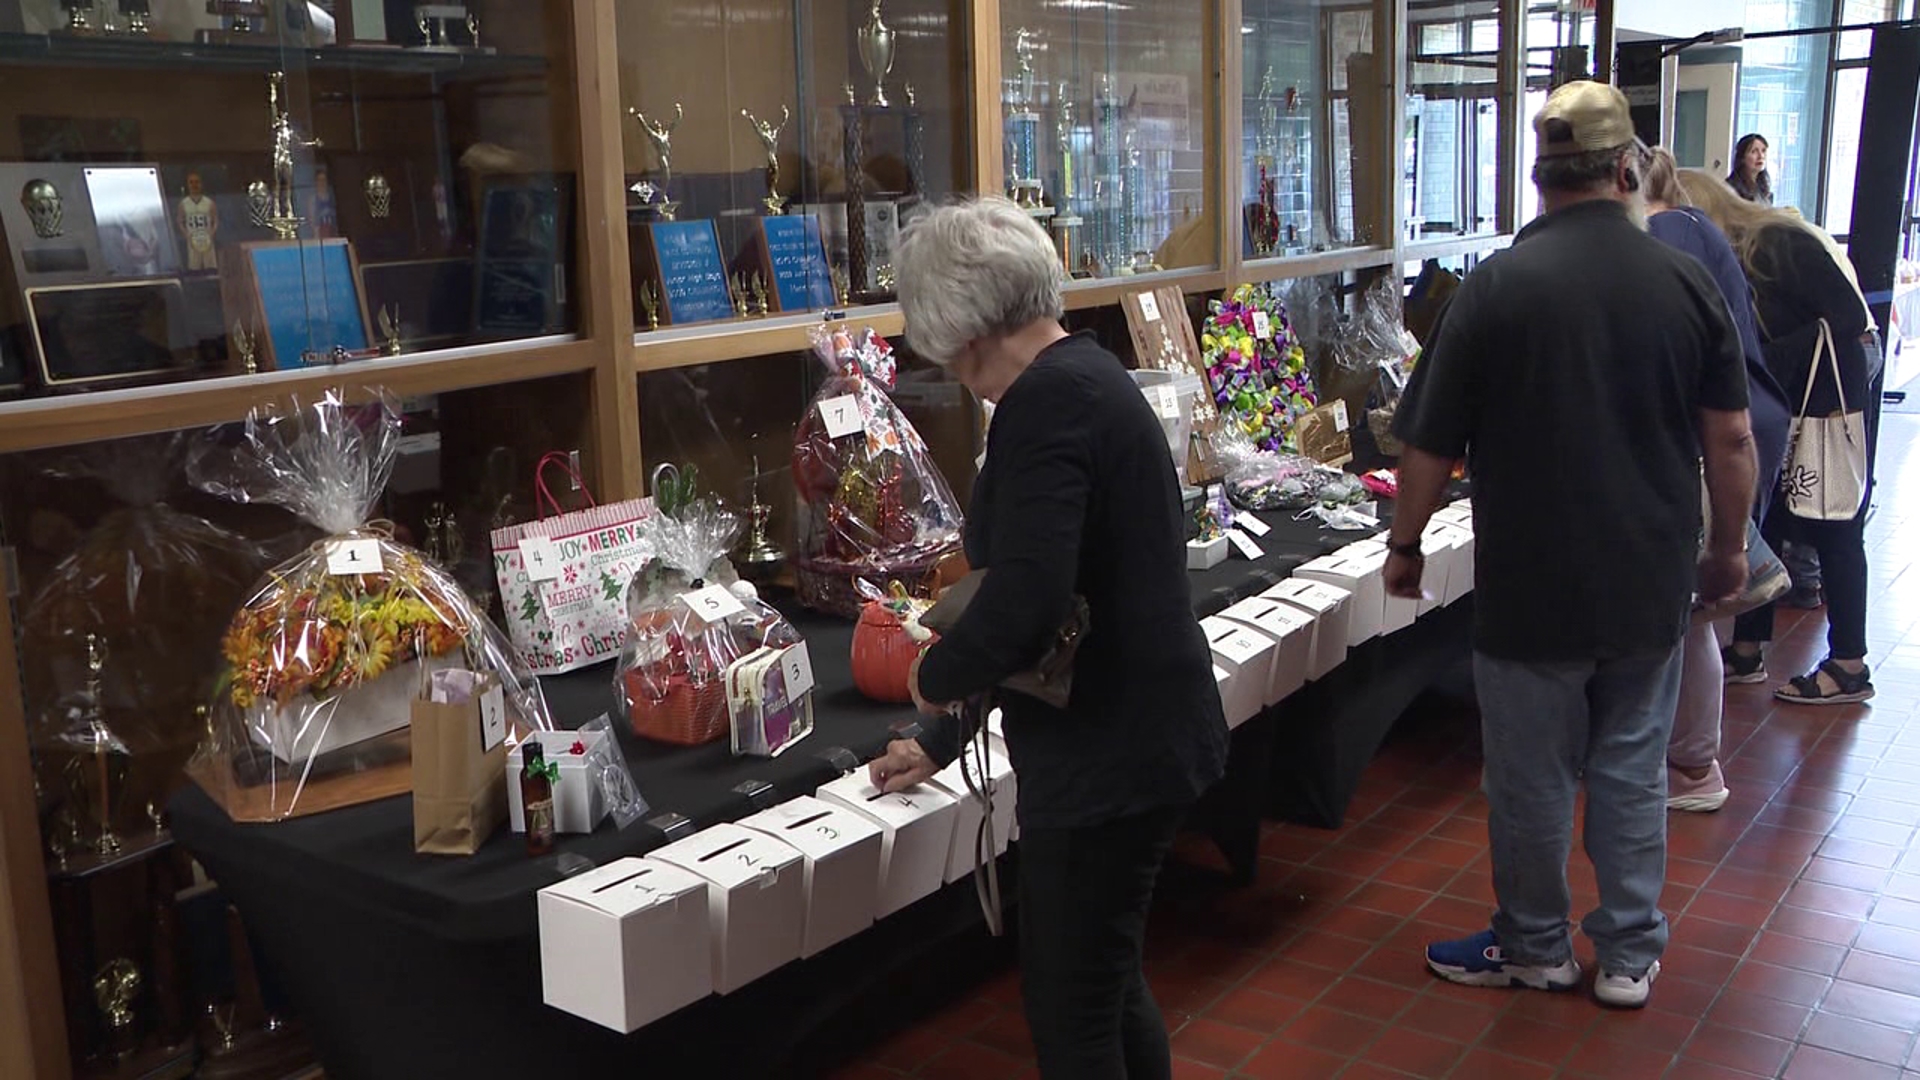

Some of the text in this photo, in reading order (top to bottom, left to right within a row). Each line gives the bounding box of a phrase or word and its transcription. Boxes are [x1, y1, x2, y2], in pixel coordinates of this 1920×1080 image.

[834, 407, 844, 425] 7
[559, 525, 636, 562] JOY MERRY
[349, 549, 361, 562] 1
[533, 549, 543, 567] 4
[547, 584, 592, 608] MERRY
[704, 597, 720, 610] 5
[791, 663, 800, 681] 3
[490, 707, 498, 728] 2
[897, 796, 920, 809] 4
[816, 825, 839, 840] 3
[737, 854, 761, 867] 2
[634, 884, 656, 894] 1
